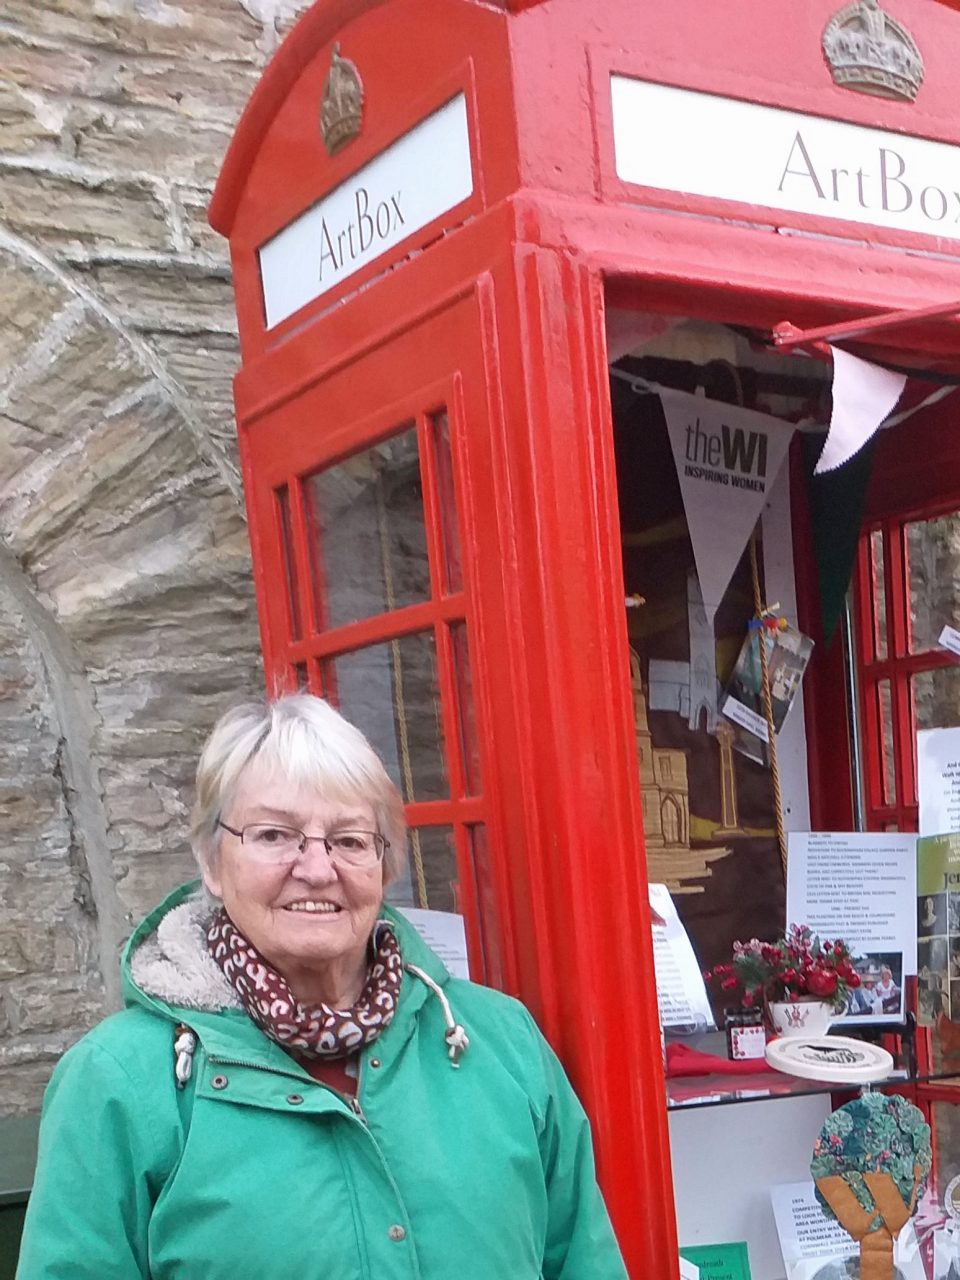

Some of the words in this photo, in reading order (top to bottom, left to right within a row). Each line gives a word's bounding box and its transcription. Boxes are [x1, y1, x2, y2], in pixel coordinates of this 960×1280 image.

[318, 187, 405, 282] ArtBox
[684, 416, 768, 478] theWI
[684, 464, 729, 486] INSPIRING
[730, 474, 766, 494] WOMEN
